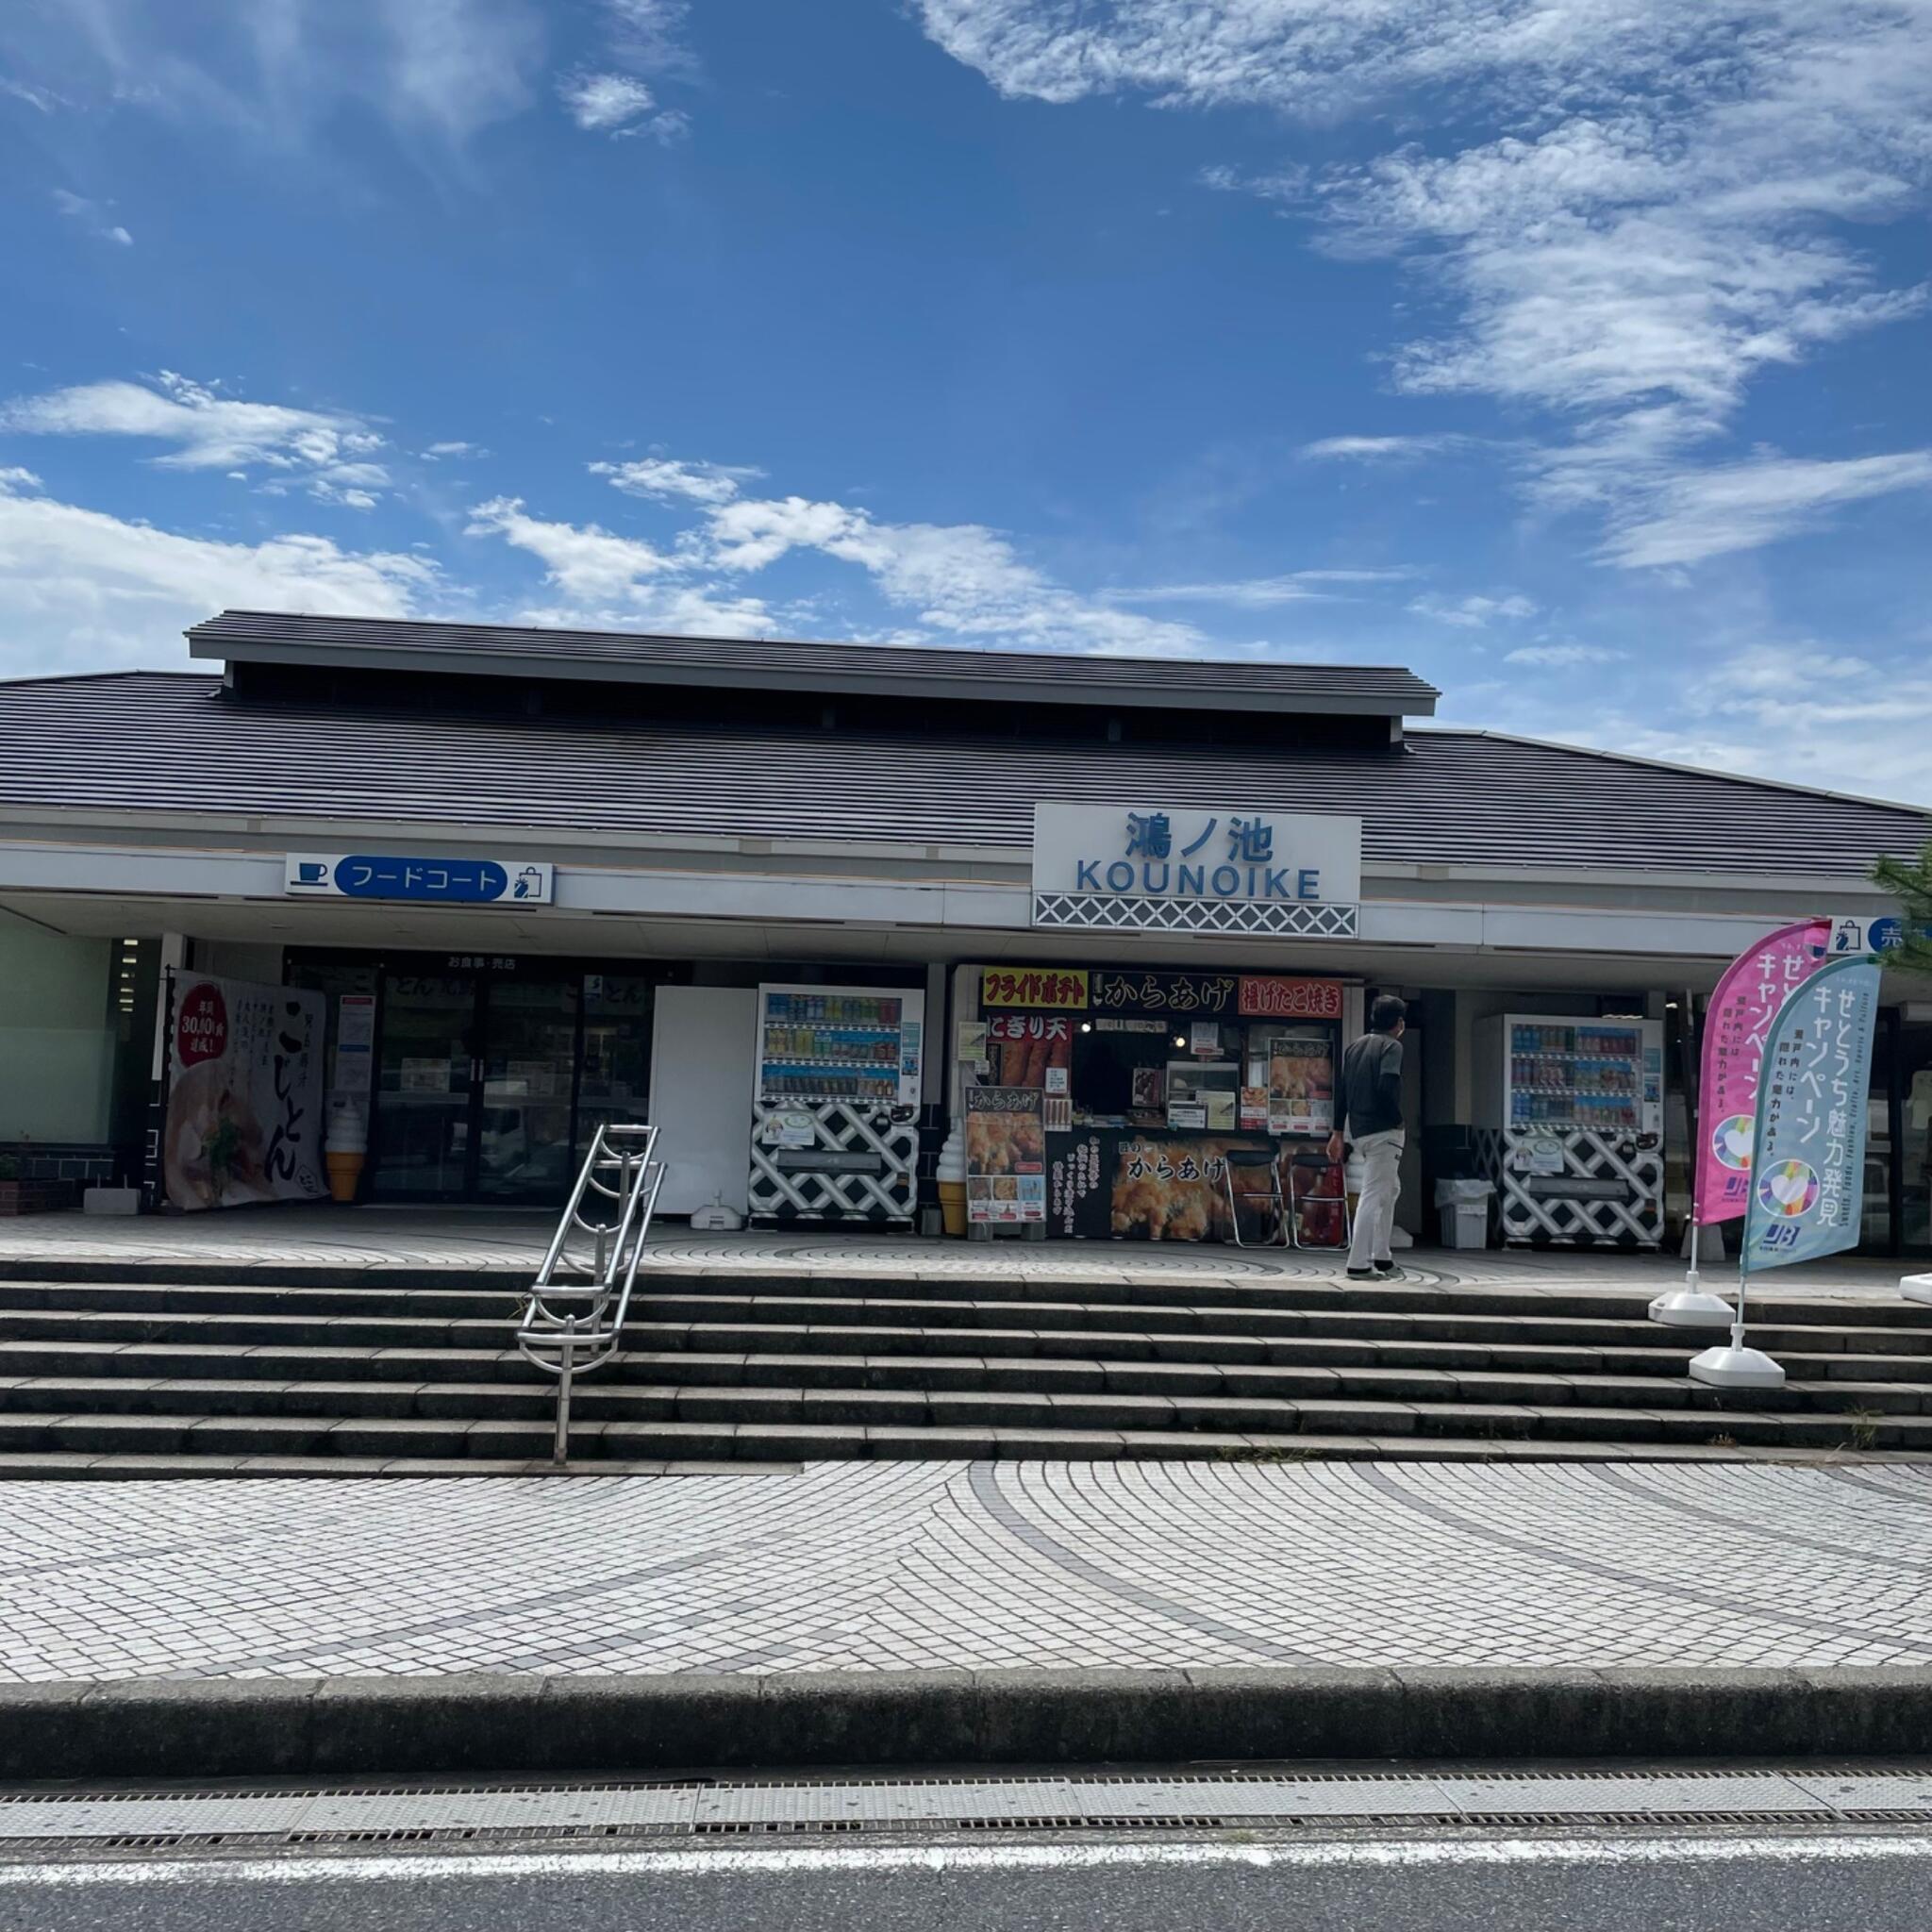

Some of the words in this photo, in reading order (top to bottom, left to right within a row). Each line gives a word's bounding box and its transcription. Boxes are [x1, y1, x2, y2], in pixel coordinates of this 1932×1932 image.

[1124, 812, 1274, 862] 鴻ノ池
[352, 867, 497, 891] フードコート
[1076, 859, 1321, 900] KOUNOIKE
[986, 973, 1085, 1006] フライドポテト
[1104, 975, 1235, 1010] からあげ
[1242, 980, 1340, 1014] 揚げたこ焼き
[1796, 987, 1832, 1144] キャンペーン
[1816, 989, 1856, 1227] せとうち魅力発見
